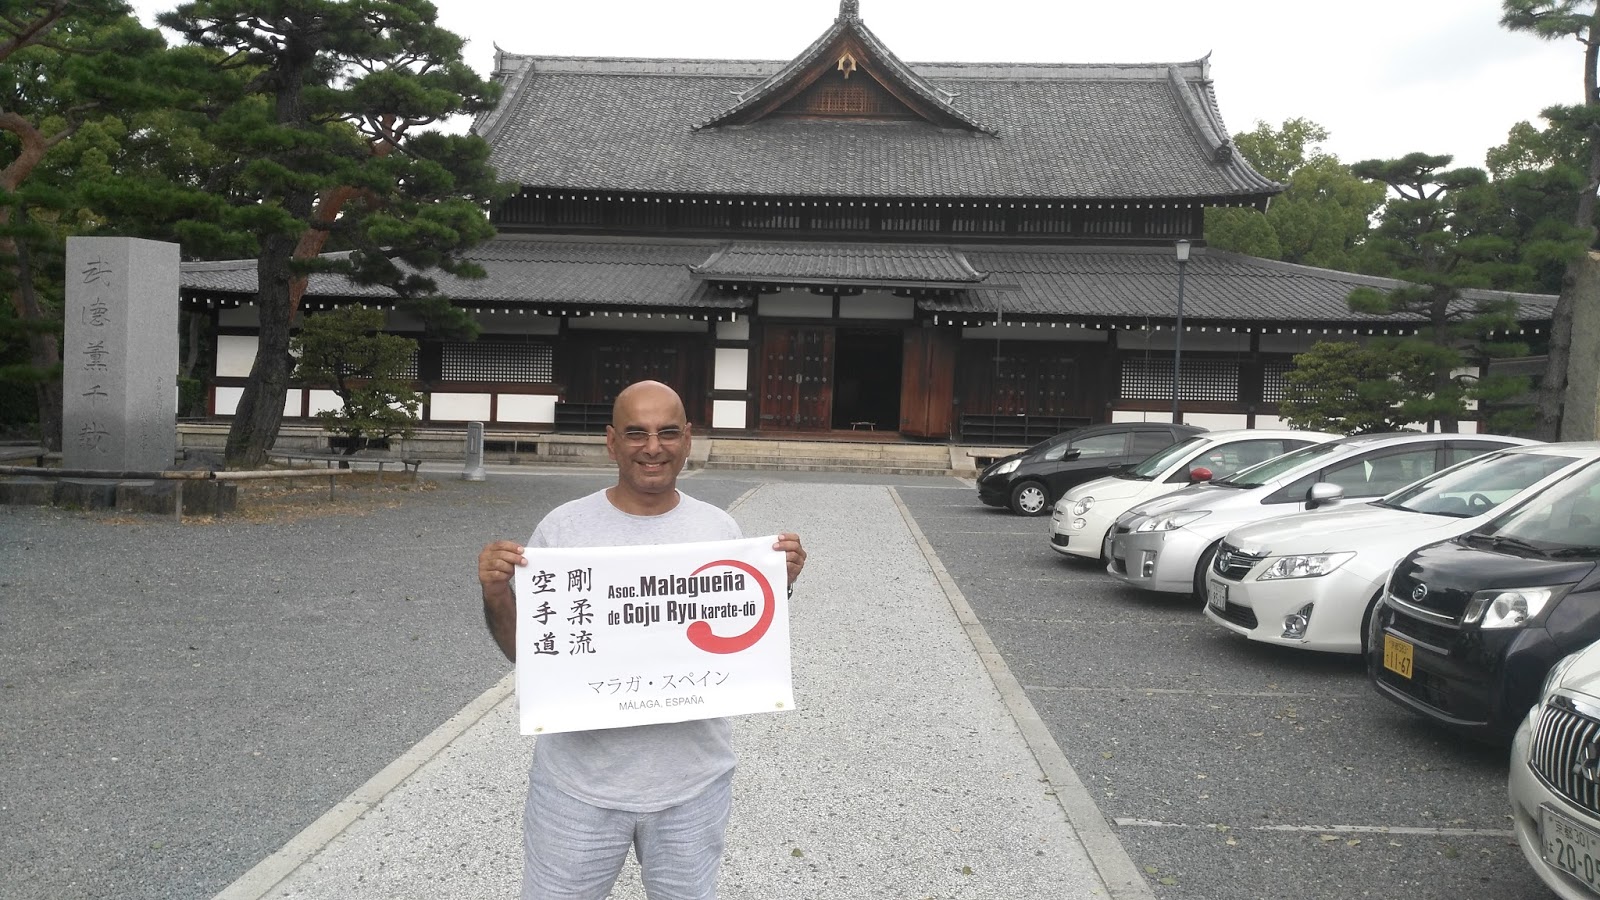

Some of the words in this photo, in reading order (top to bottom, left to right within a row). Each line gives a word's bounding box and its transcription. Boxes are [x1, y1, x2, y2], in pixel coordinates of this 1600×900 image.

[607, 585, 639, 599] Asoc.
[640, 571, 746, 598] Malagueña
[531, 569, 560, 656] 空手道
[566, 567, 597, 656] 剛柔流
[607, 610, 620, 626] de
[623, 602, 660, 627] Goju
[667, 600, 697, 625] Ryu
[588, 670, 730, 695] マラガ・スペイン
[618, 700, 663, 711] MÁLAGA,
[665, 695, 705, 707] ESPAÑA
